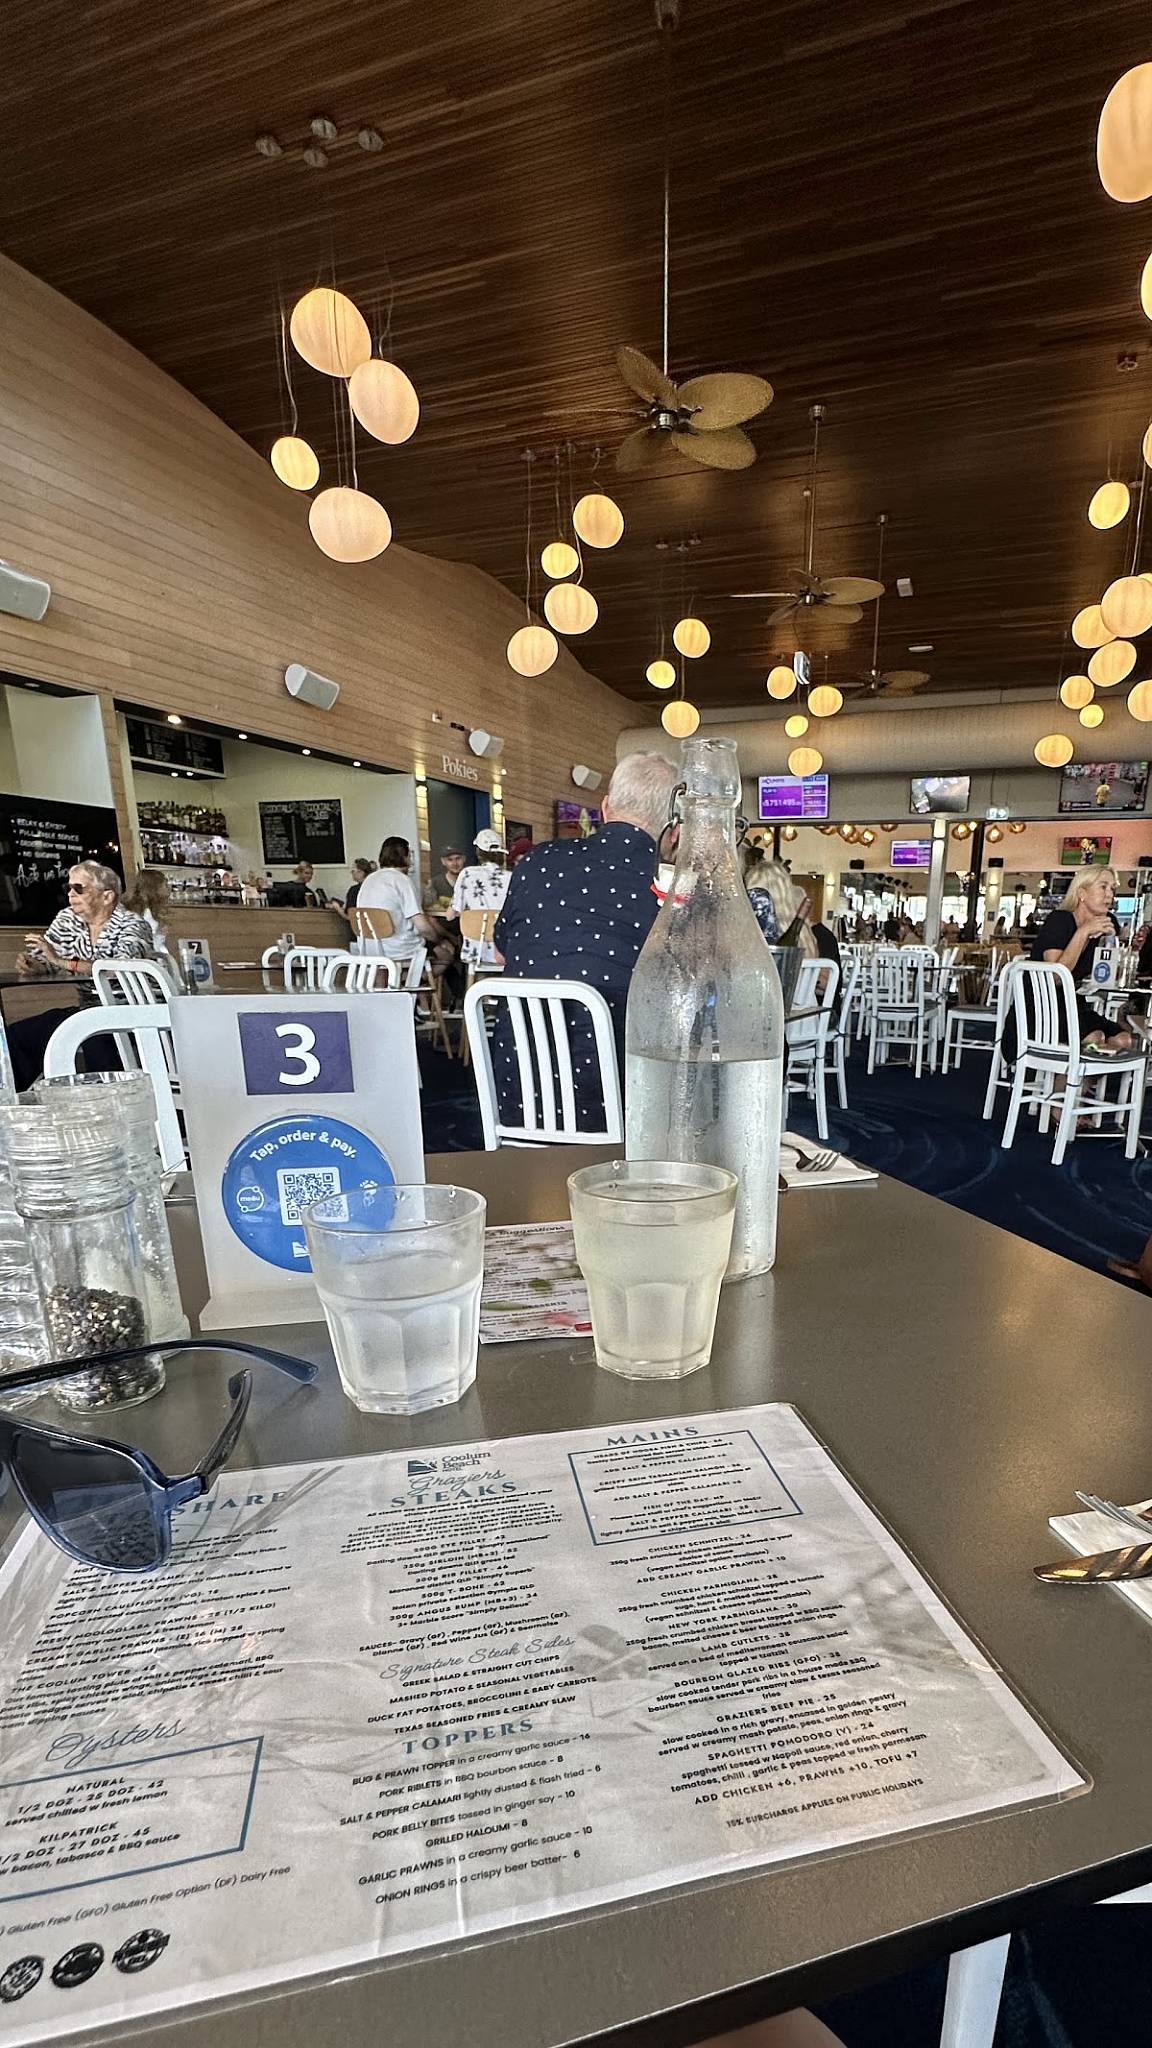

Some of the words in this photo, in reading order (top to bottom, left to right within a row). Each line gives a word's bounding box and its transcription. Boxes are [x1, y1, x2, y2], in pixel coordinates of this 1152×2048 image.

[442, 754, 479, 782] Pokies
[191, 943, 199, 954] 7
[1103, 950, 1110, 960] 11
[274, 1022, 323, 1086] 3
[249, 1142, 279, 1162] Tap,
[278, 1129, 317, 1145] order
[318, 1131, 330, 1144] &
[330, 1138, 358, 1160] pay.
[607, 1426, 698, 1446] MAINS
[441, 1452, 491, 1463] Coolum
[442, 1458, 480, 1468] Beach
[390, 1481, 516, 1507] STEAKS
[406, 1469, 508, 1496] Graziers
[169, 1490, 288, 1516] SHARE
[416, 1606, 451, 1616] ANGUS
[454, 1601, 480, 1609] RUMP
[379, 1657, 464, 1680] Signature
[468, 1642, 520, 1663] Steak
[524, 1634, 576, 1653] Sides
[701, 1643, 727, 1652] LAMB
[730, 1634, 770, 1646] CUTLETS
[36, 1676, 87, 1689] COOLUM
[92, 1669, 131, 1680] TOWER
[389, 1692, 428, 1704] MASHED
[429, 1686, 465, 1696] POTATO
[476, 1676, 521, 1688] SEASONAL
[522, 1665, 574, 1680] VEGETABLES
[402, 1677, 430, 1687] GREEK
[433, 1672, 460, 1682] SALAD
[471, 1663, 512, 1675] STRAIGHT
[514, 1659, 532, 1667] CUT
[533, 1654, 559, 1663] CHIPS
[367, 1713, 393, 1723] DUCK
[396, 1709, 413, 1717] FAT
[415, 1700, 465, 1713] POTATOES,
[467, 1690, 521, 1705] BROCCOLINI
[531, 1683, 554, 1693] BABY
[556, 1676, 597, 1687] CARROTS
[393, 1723, 423, 1734] TEXAS
[426, 1714, 474, 1728] SEASONED
[476, 1709, 501, 1719] FRIES
[511, 1700, 549, 1712] CREAMY
[551, 1695, 575, 1704] SLAW
[716, 1707, 767, 1722] GRAZIERS
[770, 1701, 793, 1711] BEEF
[797, 1697, 814, 1706] PIE
[44, 1718, 187, 1769] Oysters
[402, 1718, 532, 1754] TOPPERS
[707, 1743, 767, 1760] SPAGHETTI
[770, 1730, 832, 1748] POMODORO
[835, 1725, 851, 1736] (V)
[352, 1774, 373, 1785] BUG
[374, 1772, 382, 1781] &
[384, 1765, 419, 1779] PRAWN
[421, 1758, 455, 1771] TOPPER
[477, 1748, 512, 1760] creamy
[514, 1743, 540, 1754] garlic
[542, 1738, 570, 1748] sauce
[578, 1732, 590, 1740] 16
[65, 1776, 125, 1793] NATURAL
[378, 1786, 404, 1798] PORK
[407, 1779, 441, 1792] RIBLETS
[455, 1773, 474, 1782] BBQ
[476, 1765, 516, 1778] bourbon
[518, 1759, 546, 1769] sauce
[556, 1754, 563, 1762] 8
[694, 1793, 717, 1804] ADD
[722, 1781, 773, 1798] CHICKEN
[798, 1766, 844, 1782] PRAWNS
[873, 1753, 902, 1766] TOFU
[905, 1750, 917, 1758] +7
[5, 1812, 45, 1826] served
[46, 1805, 87, 1819] chilled
[88, 1803, 100, 1811] w
[100, 1797, 130, 1809] fresh
[131, 1790, 168, 1802] lemon
[17, 1803, 40, 1814] 1/2
[44, 1796, 73, 1809] DOZ
[107, 1785, 135, 1797] DOZ
[147, 1778, 165, 1788] 42
[745, 1805, 799, 1823] SURCHARGE
[801, 1798, 835, 1811] APPLIES
[835, 1794, 849, 1803] ON
[850, 1787, 881, 1800] PUBLIC
[881, 1778, 923, 1793] HOLIDAYS
[371, 1826, 399, 1840] PORK
[401, 1819, 428, 1833] BELLY
[429, 1814, 455, 1830] BITES
[458, 1807, 490, 1820] tossed
[504, 1798, 535, 1812] ginger
[537, 1795, 554, 1804] soy
[565, 1789, 575, 1798] 10
[38, 1821, 118, 1844] KILPATRICK
[425, 1832, 463, 1848] GRILLED
[465, 1822, 510, 1838] HALOUMI
[521, 1818, 528, 1827] 8
[374, 1888, 410, 1904] ONION
[413, 1879, 445, 1895] RINGS
[447, 1878, 457, 1886] in
[459, 1875, 467, 1883] a
[470, 1867, 501, 1881] crispy
[504, 1862, 527, 1873] beer
[573, 1849, 580, 1858] 6
